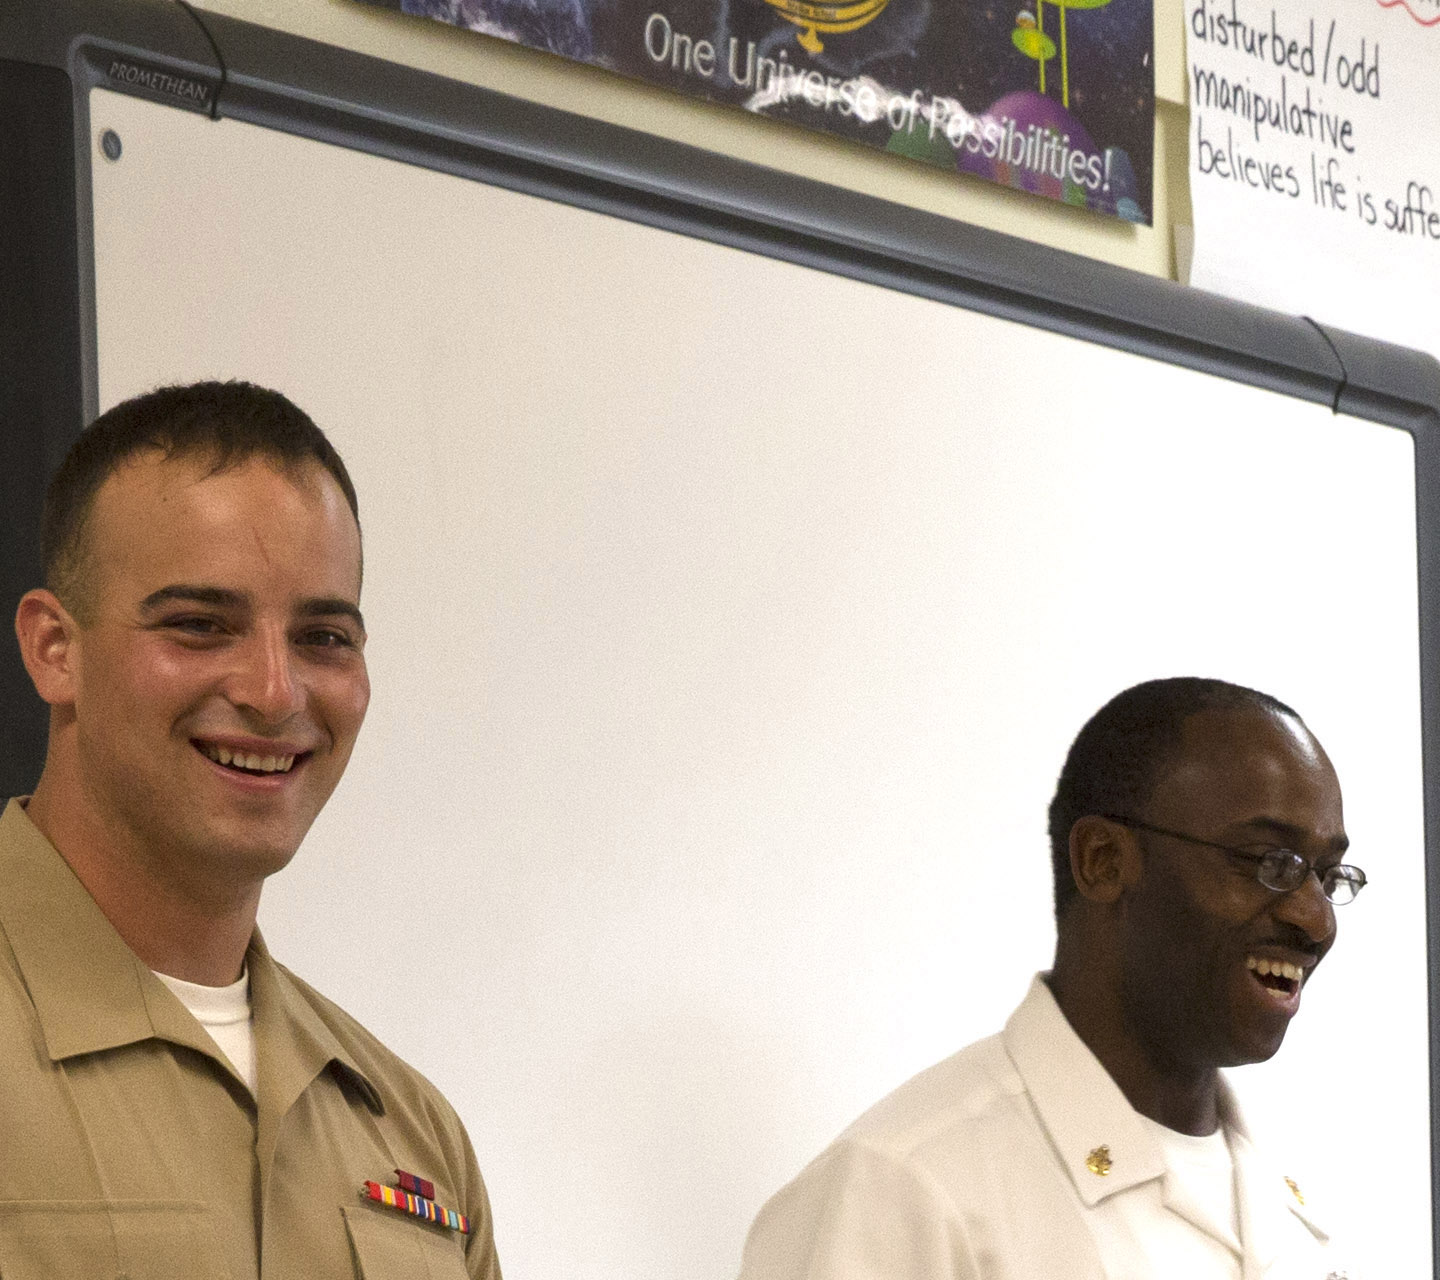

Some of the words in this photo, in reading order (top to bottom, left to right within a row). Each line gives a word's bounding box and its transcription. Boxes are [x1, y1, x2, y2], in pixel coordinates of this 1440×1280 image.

[109, 61, 207, 100] PROMETHEAN
[1192, 0, 1380, 98] disturbed/odd
[644, 12, 715, 77] One
[888, 88, 924, 133] of
[929, 95, 1114, 192] Possibilities!
[1194, 62, 1355, 154] manipulative
[1198, 114, 1300, 198] believes
[1311, 153, 1347, 211] life
[1356, 175, 1377, 226] is
